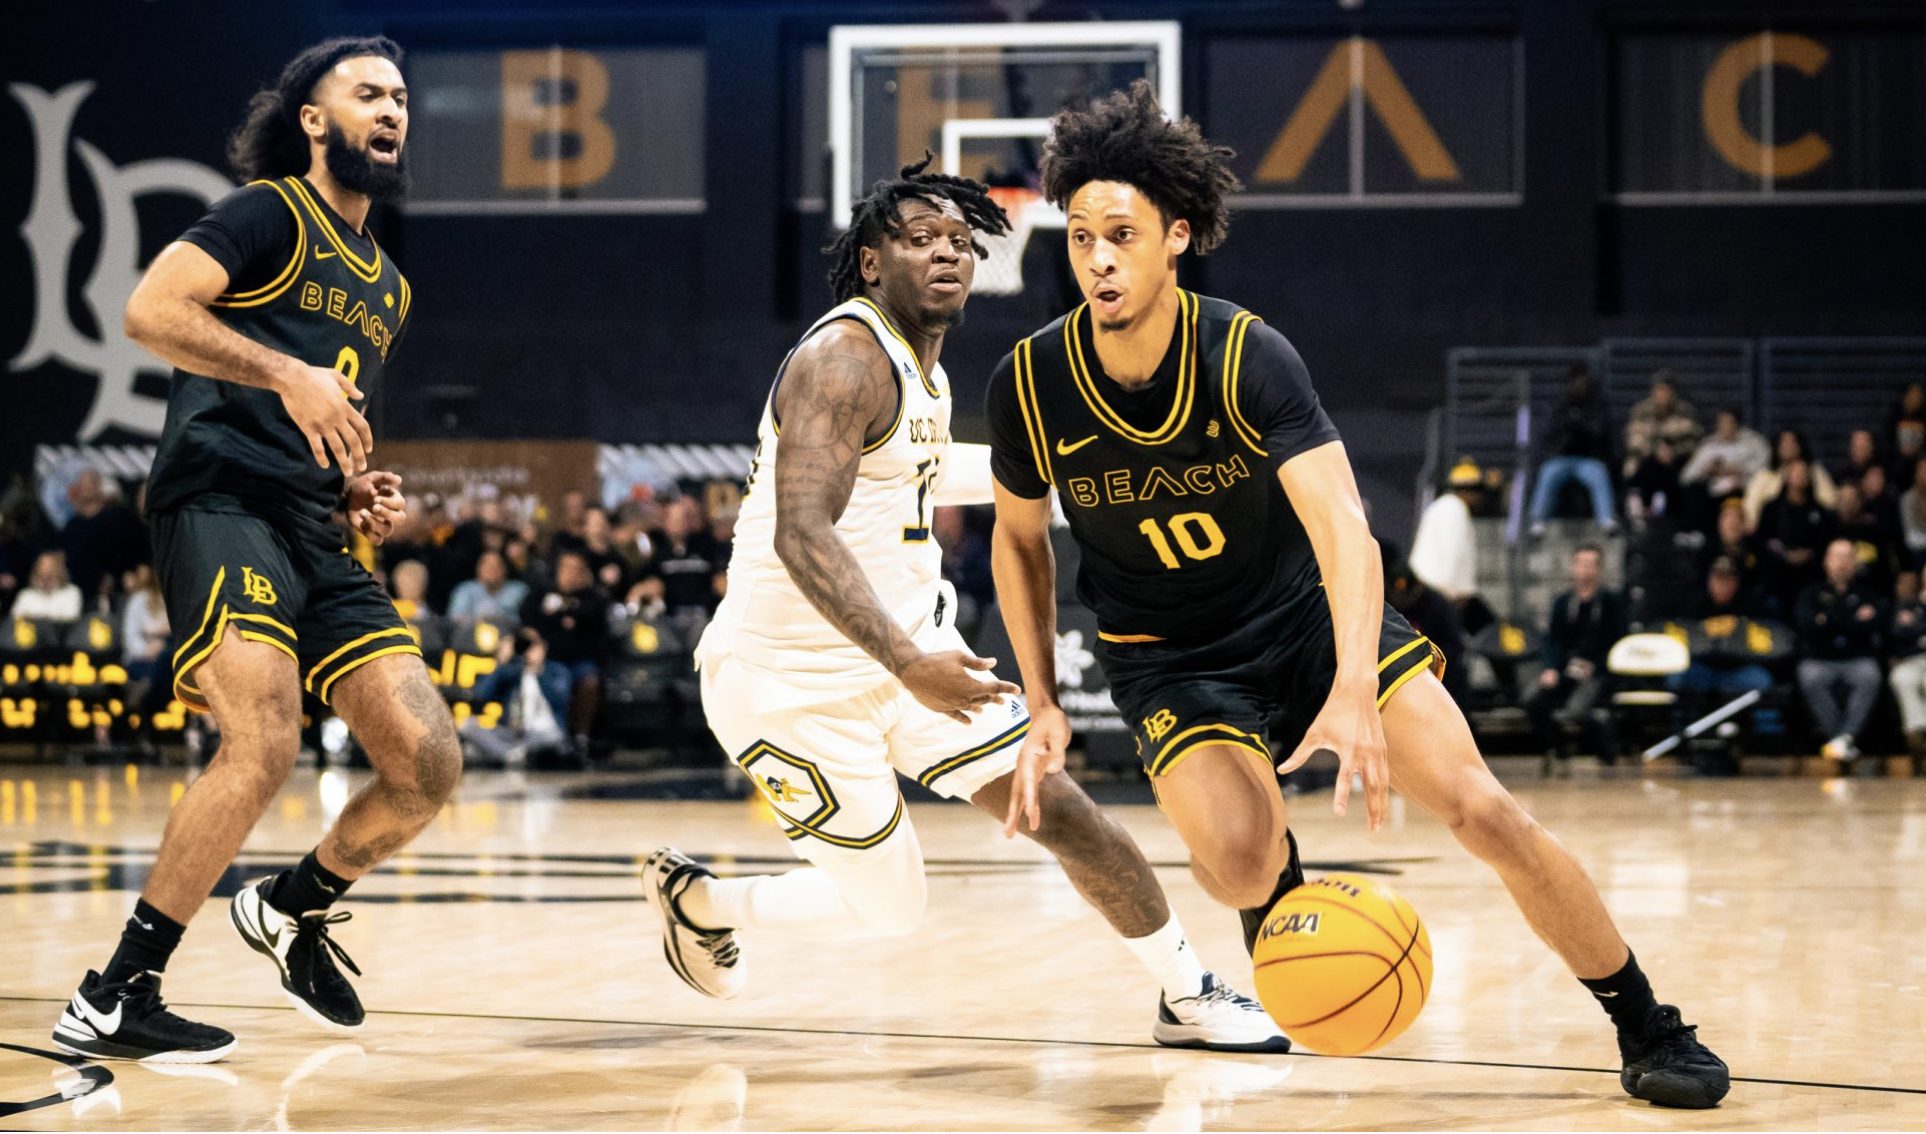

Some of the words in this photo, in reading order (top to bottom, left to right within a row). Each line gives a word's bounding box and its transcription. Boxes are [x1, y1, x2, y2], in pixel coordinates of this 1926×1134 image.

[501, 48, 616, 189] B
[1703, 32, 1833, 178] C
[1068, 454, 1250, 507] BEACH
[1138, 512, 1226, 569] 10
[1259, 912, 1320, 944] NCAA
